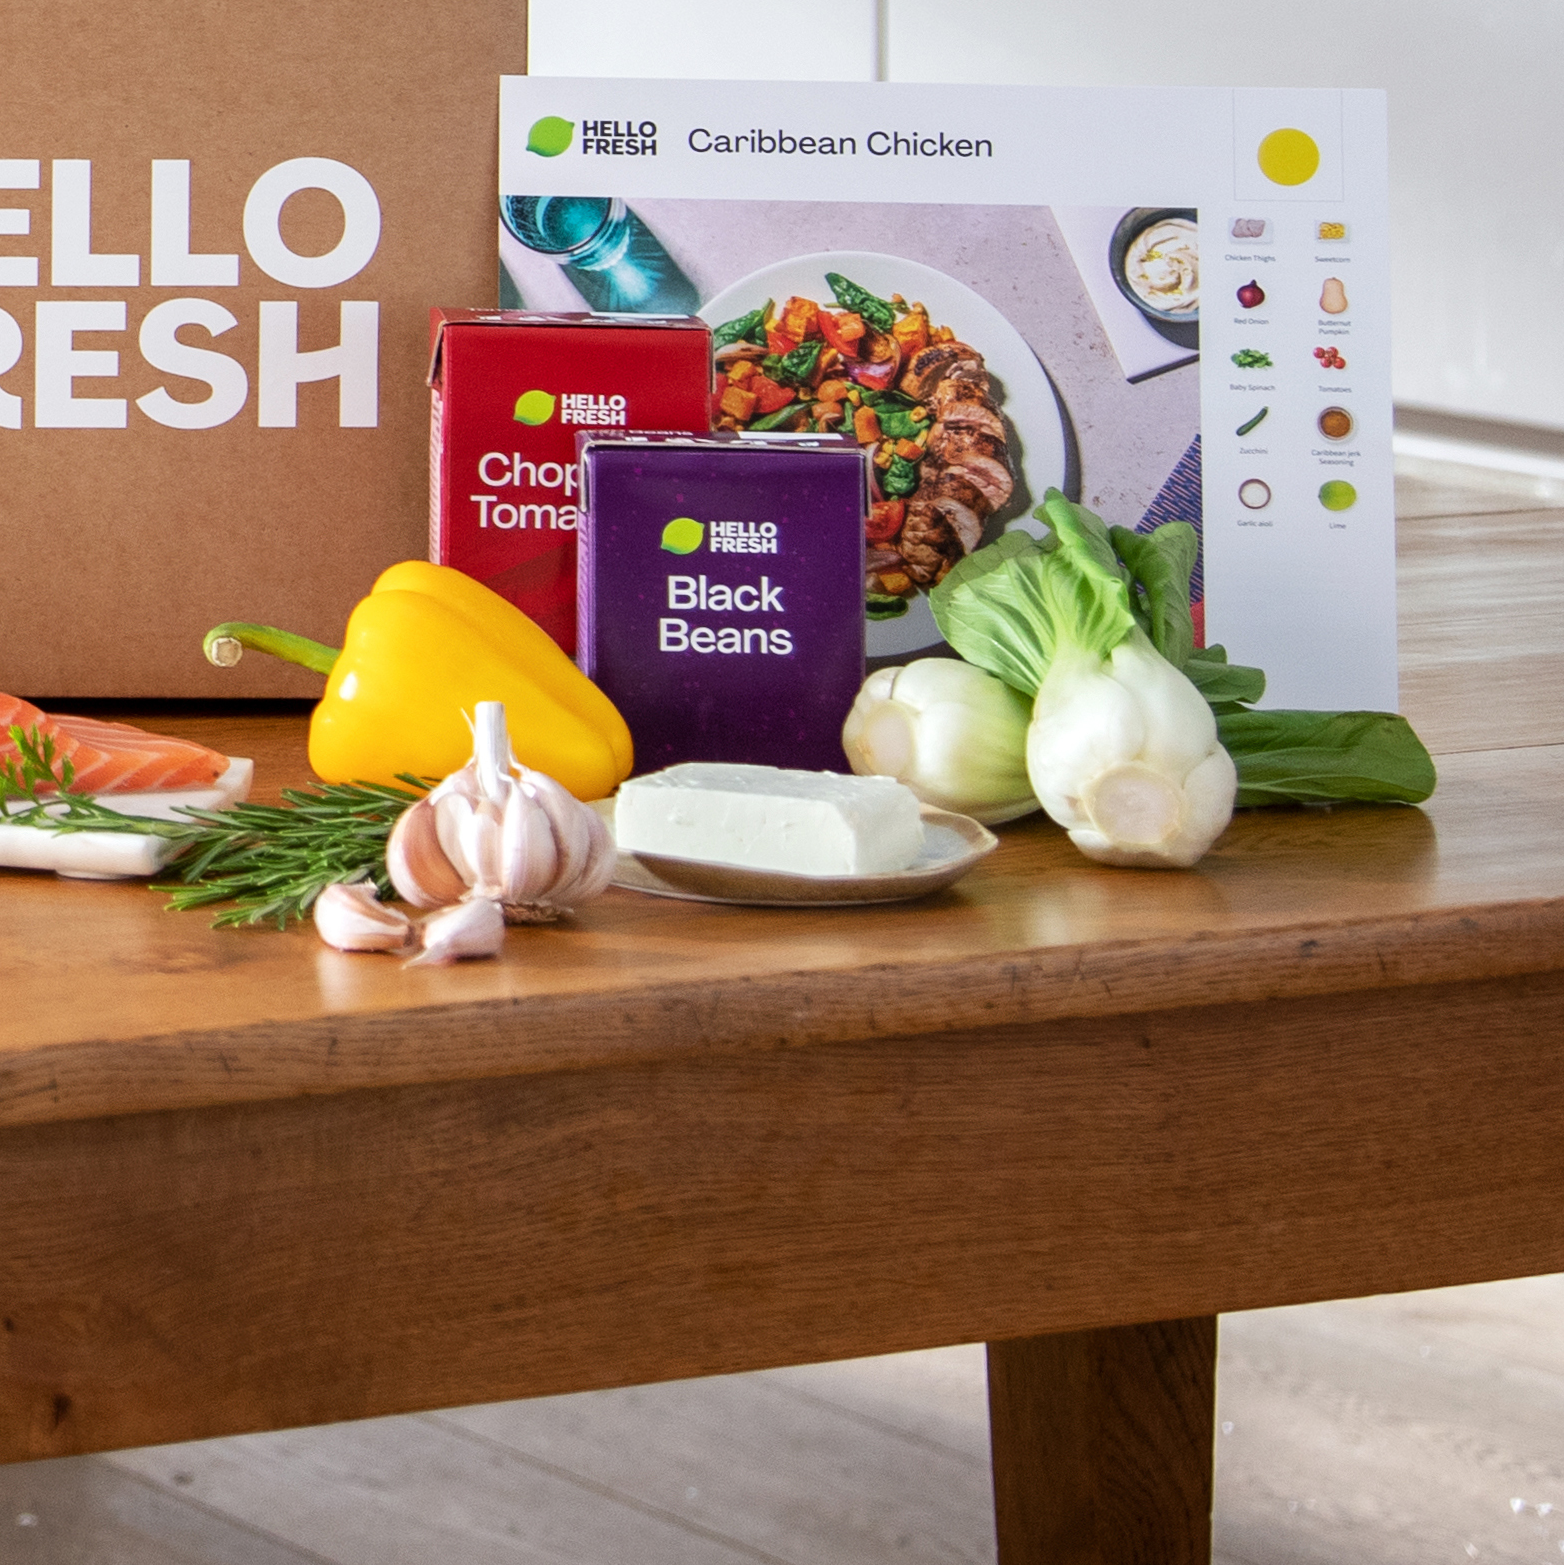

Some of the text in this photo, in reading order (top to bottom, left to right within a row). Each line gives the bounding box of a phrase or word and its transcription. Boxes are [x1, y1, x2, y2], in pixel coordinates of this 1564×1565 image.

[582, 120, 658, 138] HELLO
[582, 138, 658, 156] FRESH
[687, 128, 993, 158] Caribbean Chicken
[1225, 254, 1276, 263] Chicken Thighs
[1229, 384, 1275, 392] Baby Spinach
[561, 393, 627, 410] HELLO
[561, 410, 627, 426] FRESH
[1319, 459, 1354, 467] Seasoning
[709, 521, 777, 538] HELLO
[709, 537, 777, 554] FRESH
[667, 575, 785, 613] Black
[658, 617, 794, 655] Beans
